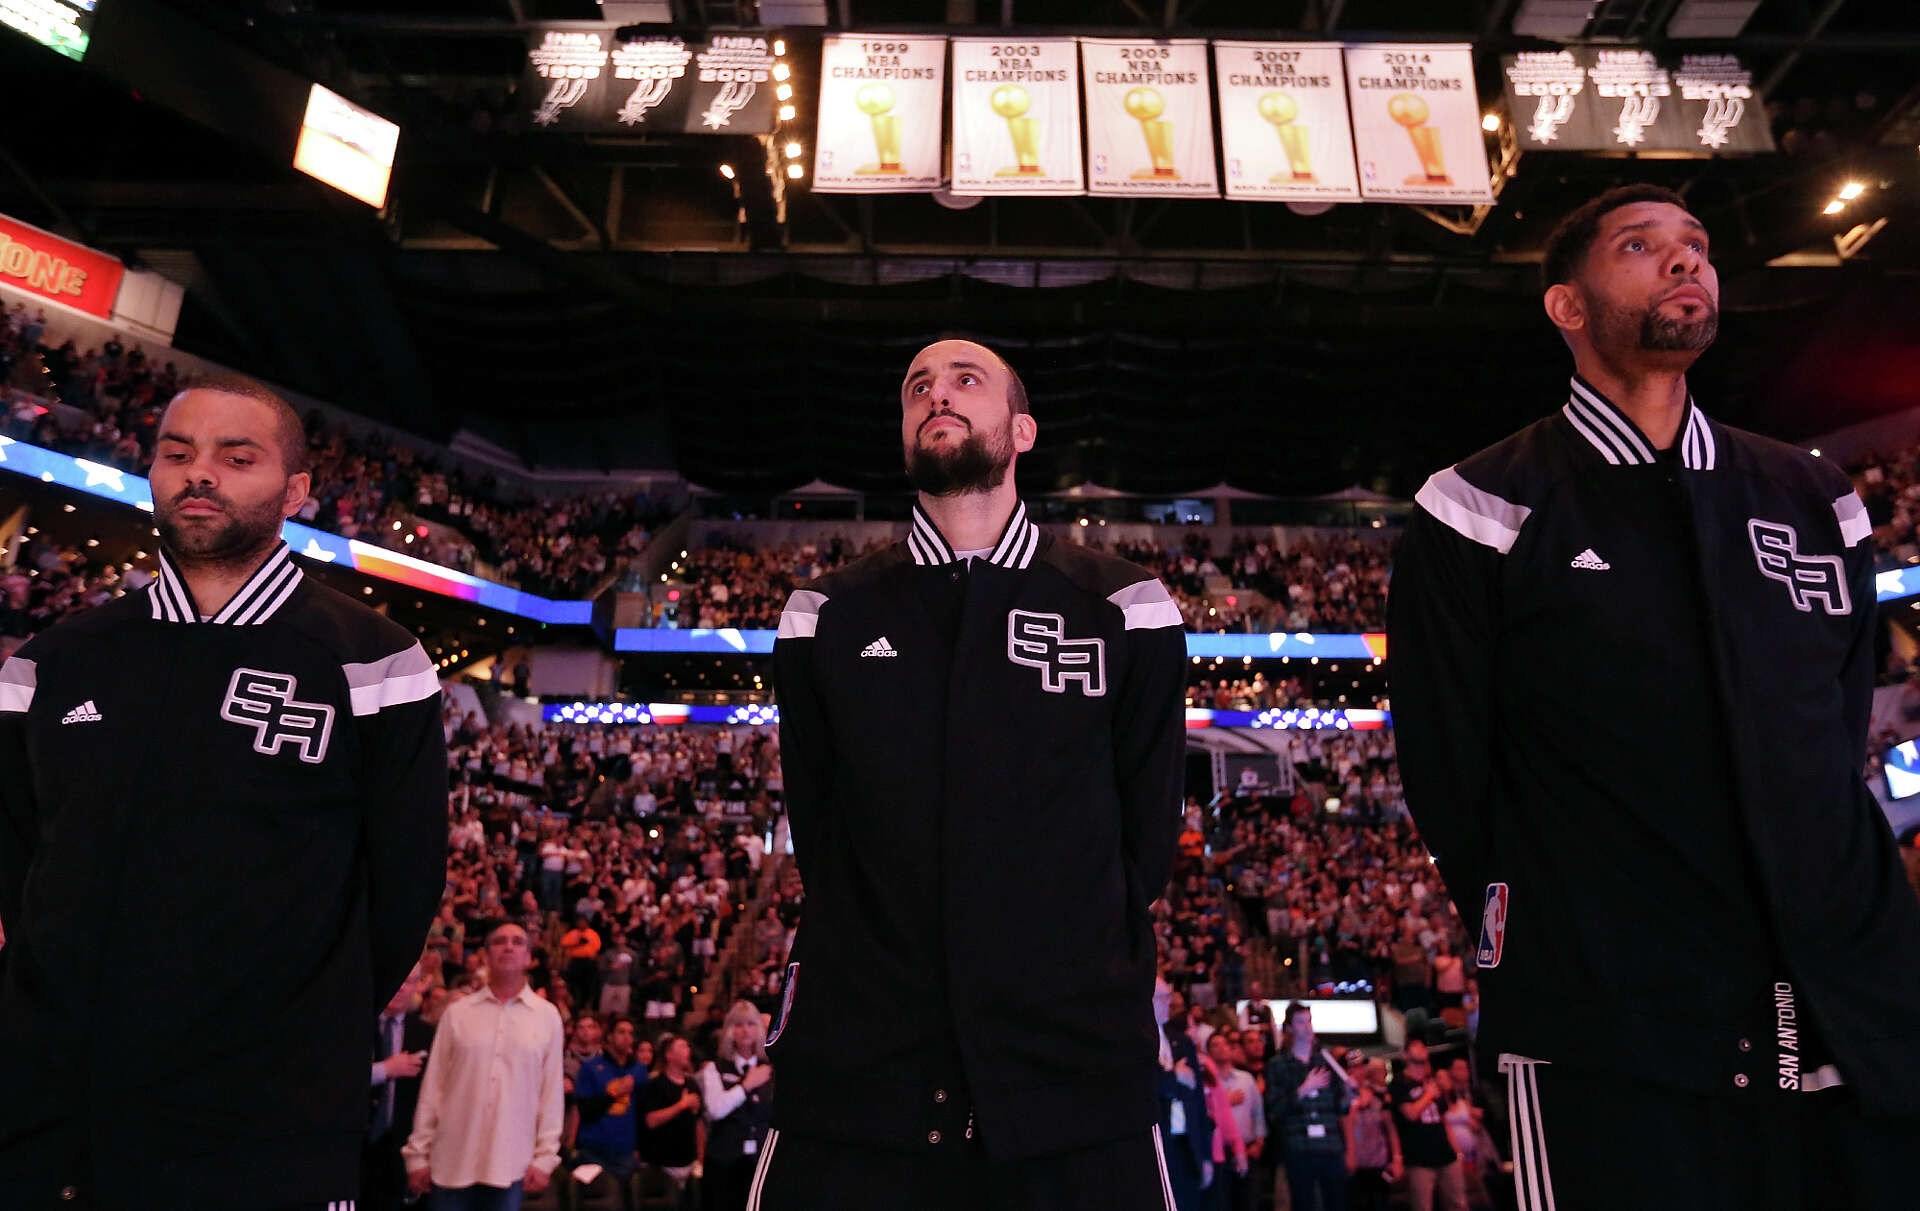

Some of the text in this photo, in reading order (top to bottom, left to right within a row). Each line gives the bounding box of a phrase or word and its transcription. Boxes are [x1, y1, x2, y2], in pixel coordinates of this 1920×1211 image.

[862, 43, 908, 53] 1999
[991, 45, 1041, 57] 2003
[1120, 48, 1170, 59] 2005
[867, 55, 901, 66] NBA
[1254, 51, 1301, 62] 2007
[1384, 53, 1431, 64] 2014
[1000, 58, 1033, 70] NBA
[1128, 60, 1162, 72] NBA
[1262, 63, 1296, 75] NBA
[832, 67, 935, 80] CHAMPIONS
[966, 70, 1067, 82] CHAMPIONS
[1392, 66, 1426, 77] NBA
[1095, 72, 1198, 85] CHAMPIONS
[1229, 74, 1331, 88] CHAMPIONS
[1359, 77, 1463, 90] CHAMPIONS
[1570, 559, 1611, 570] adidas
[860, 649, 898, 658] adidas
[1008, 608, 1107, 697] SA
[62, 713, 103, 725] adidas
[220, 667, 335, 764] SA
[1774, 982, 1799, 1090] SAN ANTONIO
